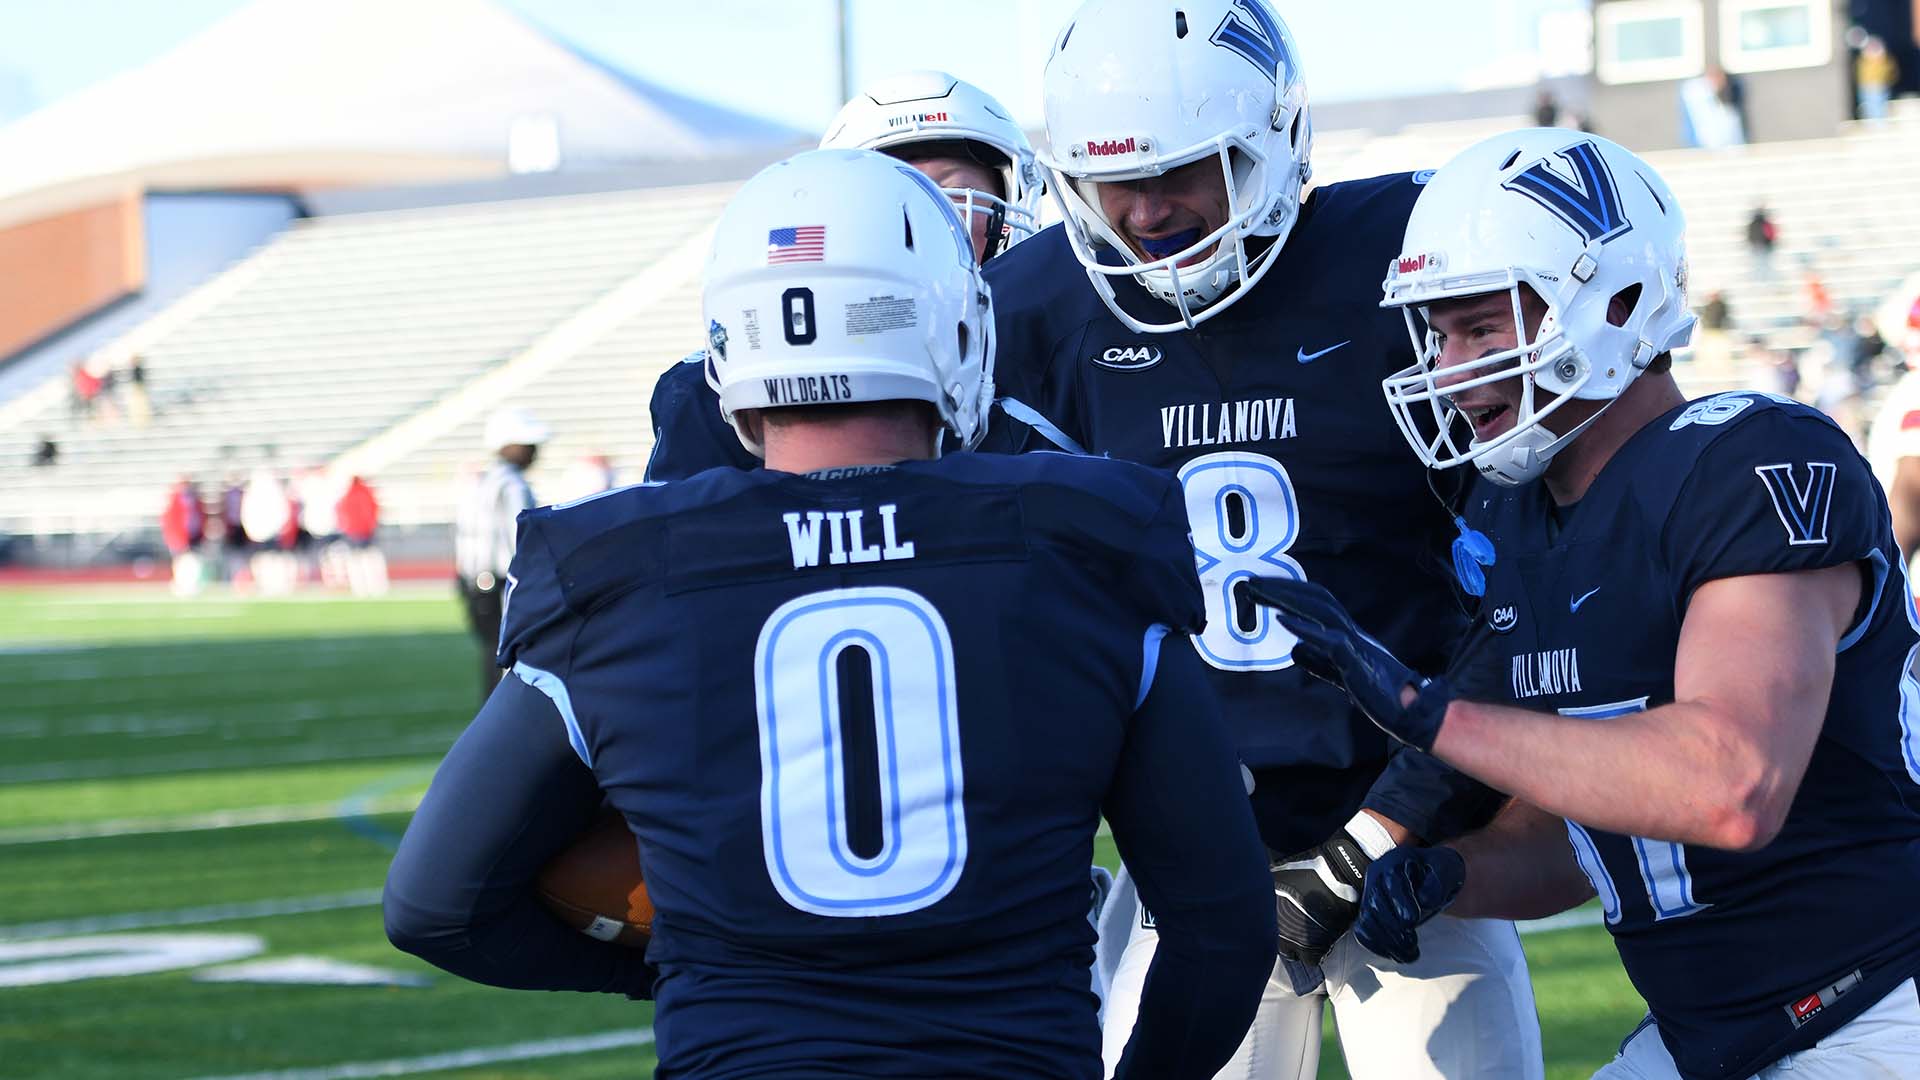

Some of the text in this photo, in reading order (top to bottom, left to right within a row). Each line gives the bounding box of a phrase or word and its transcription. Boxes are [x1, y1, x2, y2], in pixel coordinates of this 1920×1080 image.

[1209, 0, 1297, 97] V
[1087, 137, 1136, 156] Riddell
[1500, 139, 1634, 249] V
[1398, 254, 1426, 273] ddell
[781, 287, 817, 346] 0
[1102, 346, 1152, 362] CAA
[763, 374, 852, 404] WILDCATS
[1160, 398, 1298, 448] VILLANOVA
[1754, 462, 1837, 545] V
[783, 504, 915, 570] WILL
[1177, 451, 1308, 672] 8
[1493, 606, 1514, 624] CAA
[1512, 647, 1582, 699] VILLANOVA
[754, 586, 968, 917] 0
[1336, 845, 1363, 879] CUTTERS
[1801, 1006, 1822, 1020] TEAM
[1831, 985, 1845, 996] L
